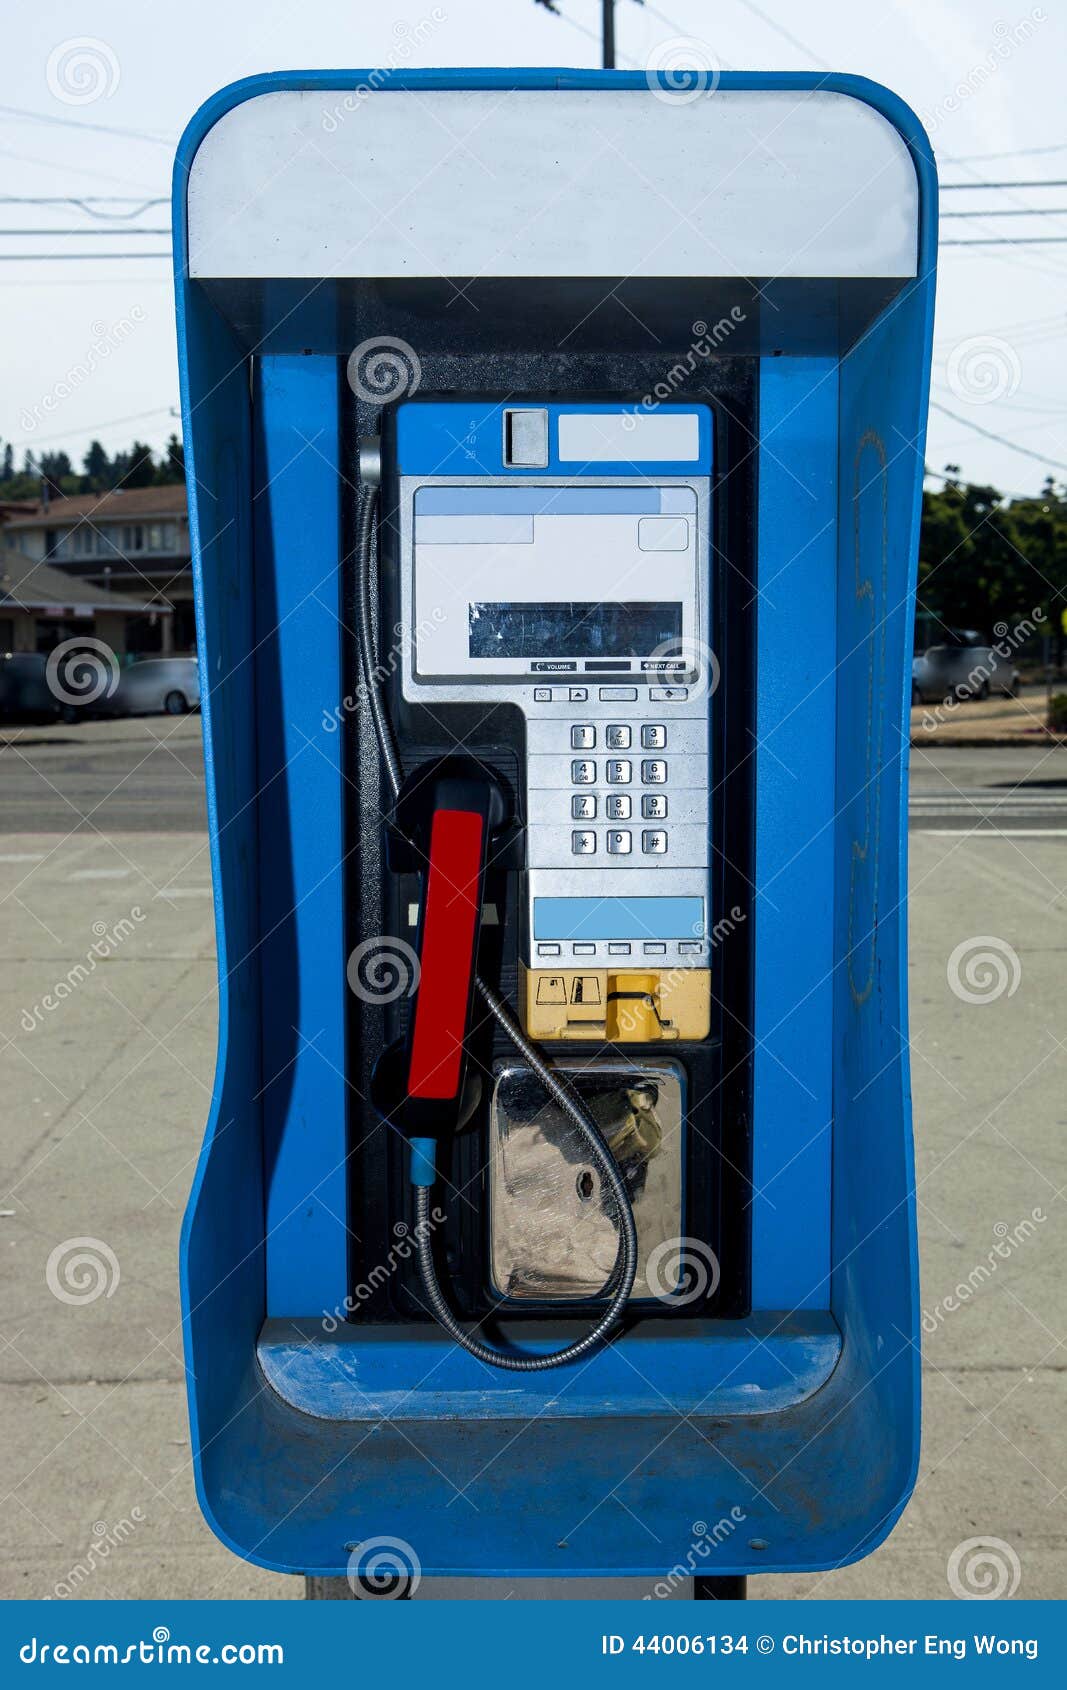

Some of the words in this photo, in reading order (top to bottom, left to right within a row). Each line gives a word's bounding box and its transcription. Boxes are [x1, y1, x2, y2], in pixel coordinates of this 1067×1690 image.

[580, 728, 586, 738] 1
[616, 729, 623, 738] 2
[650, 728, 657, 738] 3
[580, 763, 587, 773] 4
[615, 763, 622, 773] 5
[651, 763, 658, 773] 6
[580, 798, 588, 808] 7
[615, 798, 622, 808] 8
[651, 798, 658, 808] 9
